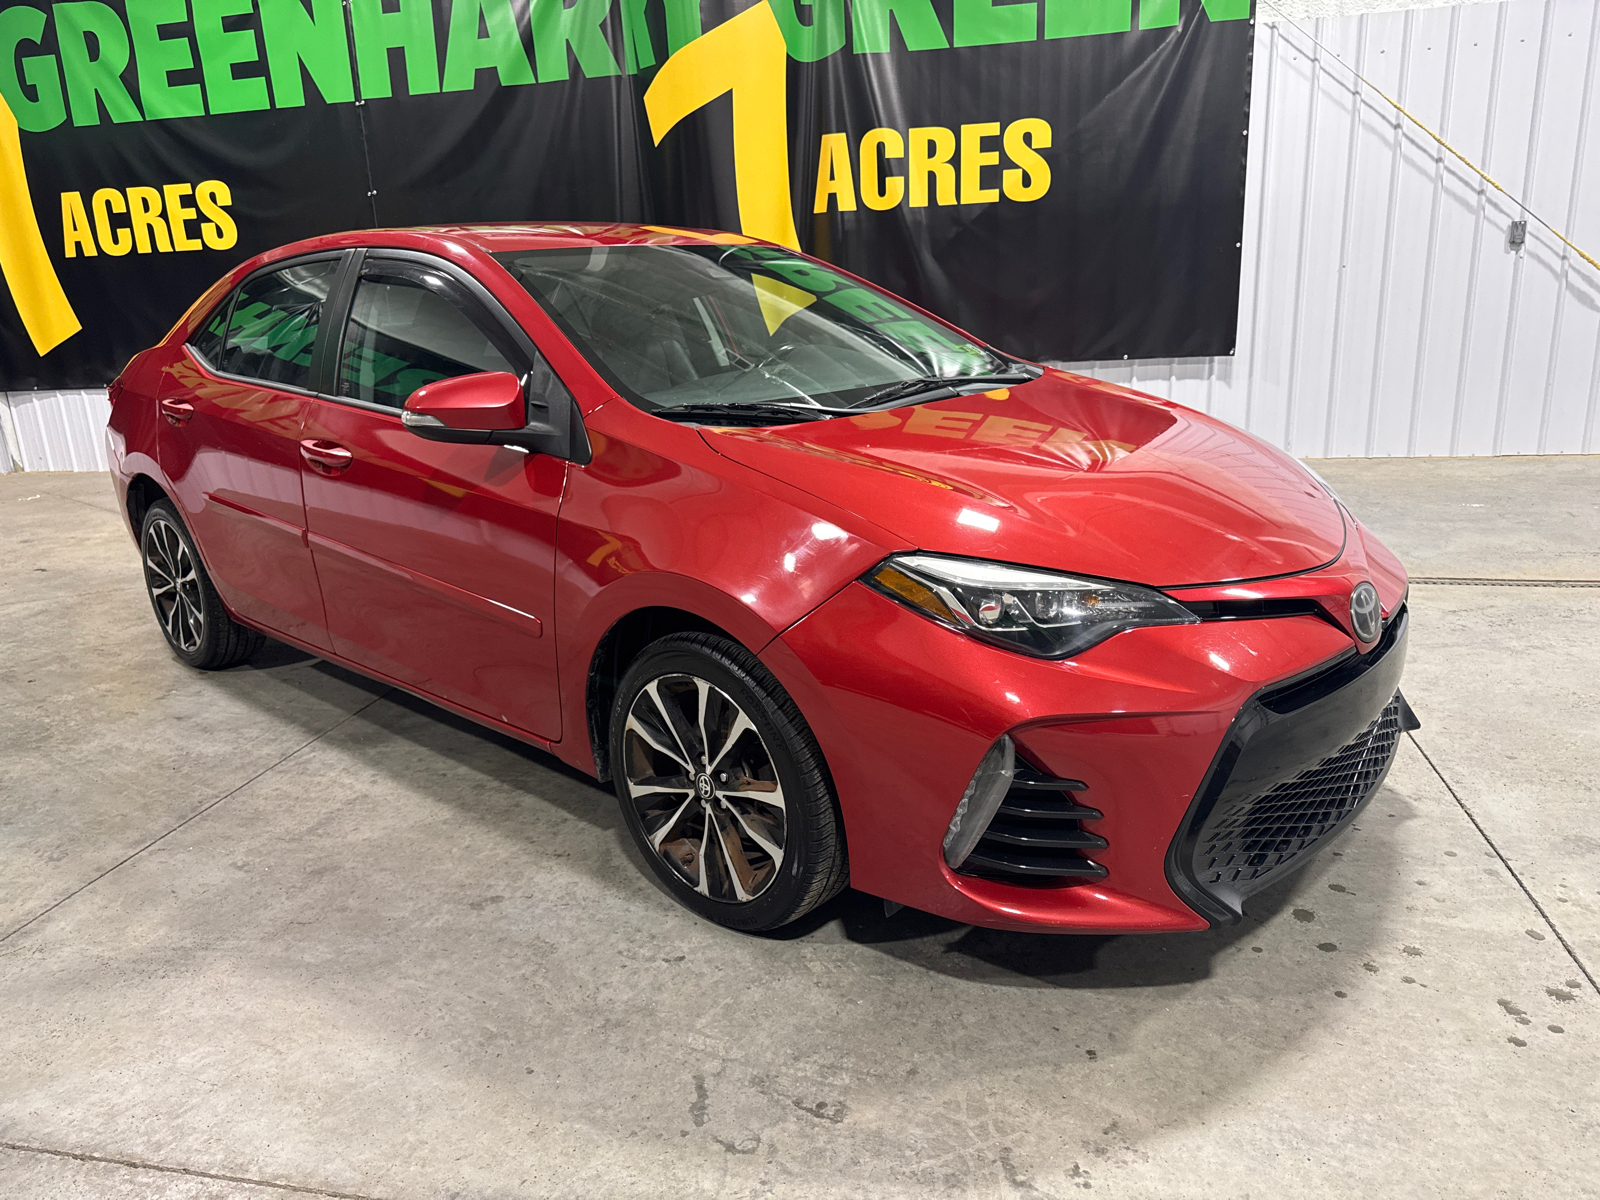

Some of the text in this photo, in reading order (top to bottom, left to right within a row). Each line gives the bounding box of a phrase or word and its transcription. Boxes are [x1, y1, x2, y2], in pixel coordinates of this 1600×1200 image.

[644, 0, 1052, 253] 7 ACRES
[60, 180, 238, 258] ACRES
